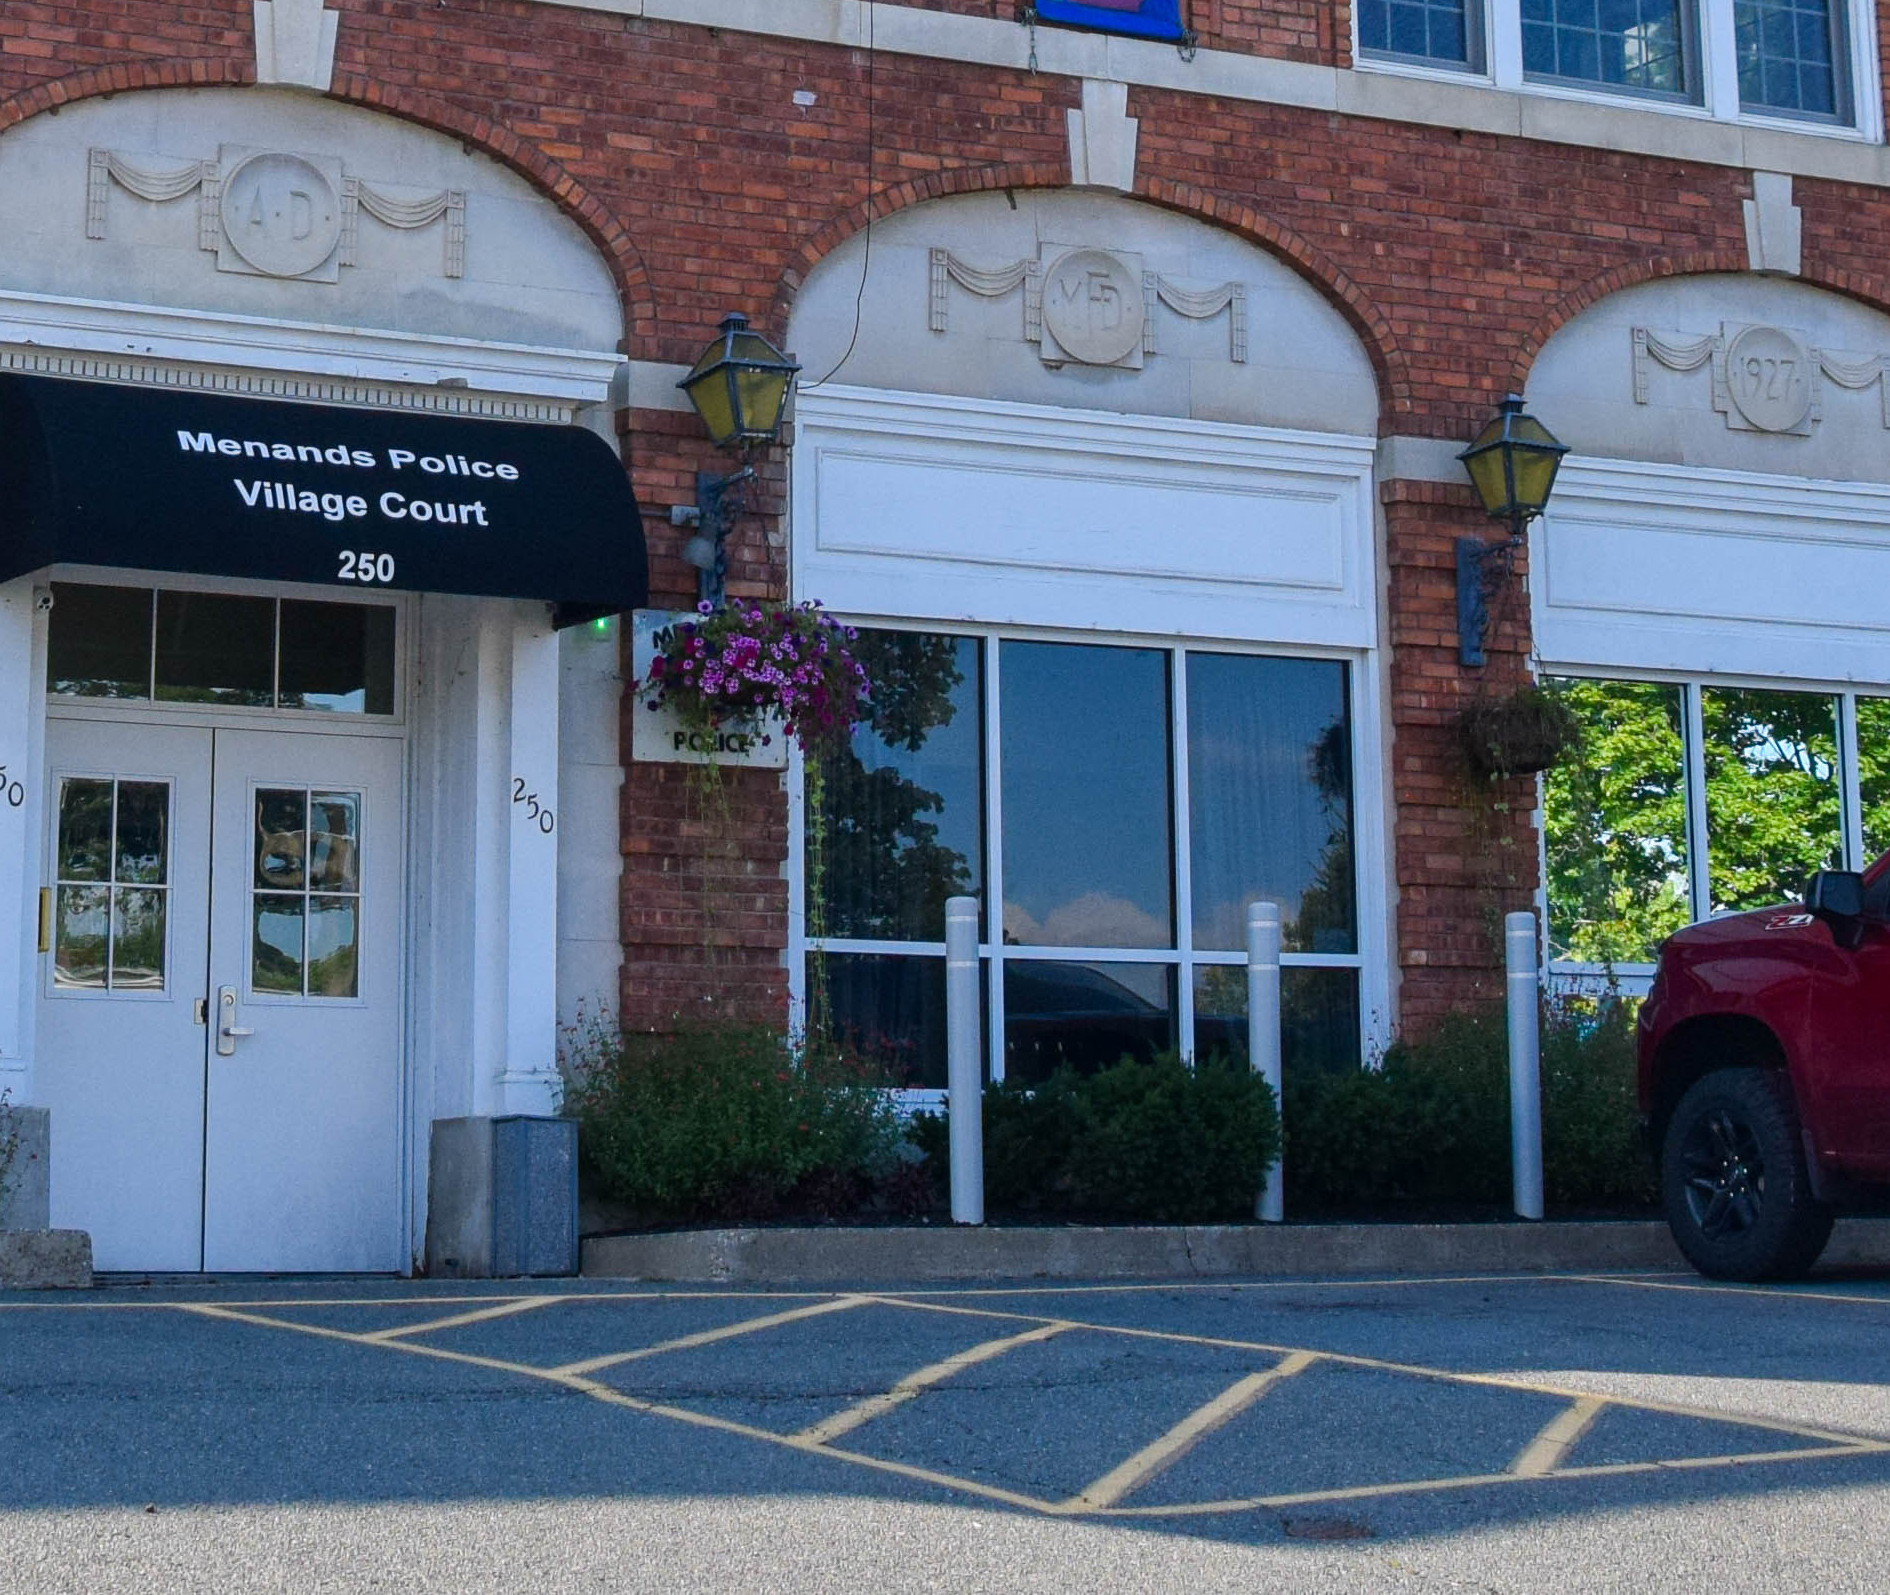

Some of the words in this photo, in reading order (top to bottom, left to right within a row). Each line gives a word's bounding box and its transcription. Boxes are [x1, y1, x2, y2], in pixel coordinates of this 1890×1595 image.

[177, 430, 377, 468] Menands
[388, 448, 520, 480] Police
[234, 479, 368, 521] Village
[379, 491, 489, 526] Court
[337, 550, 396, 582] 250
[513, 777, 554, 834] 250
